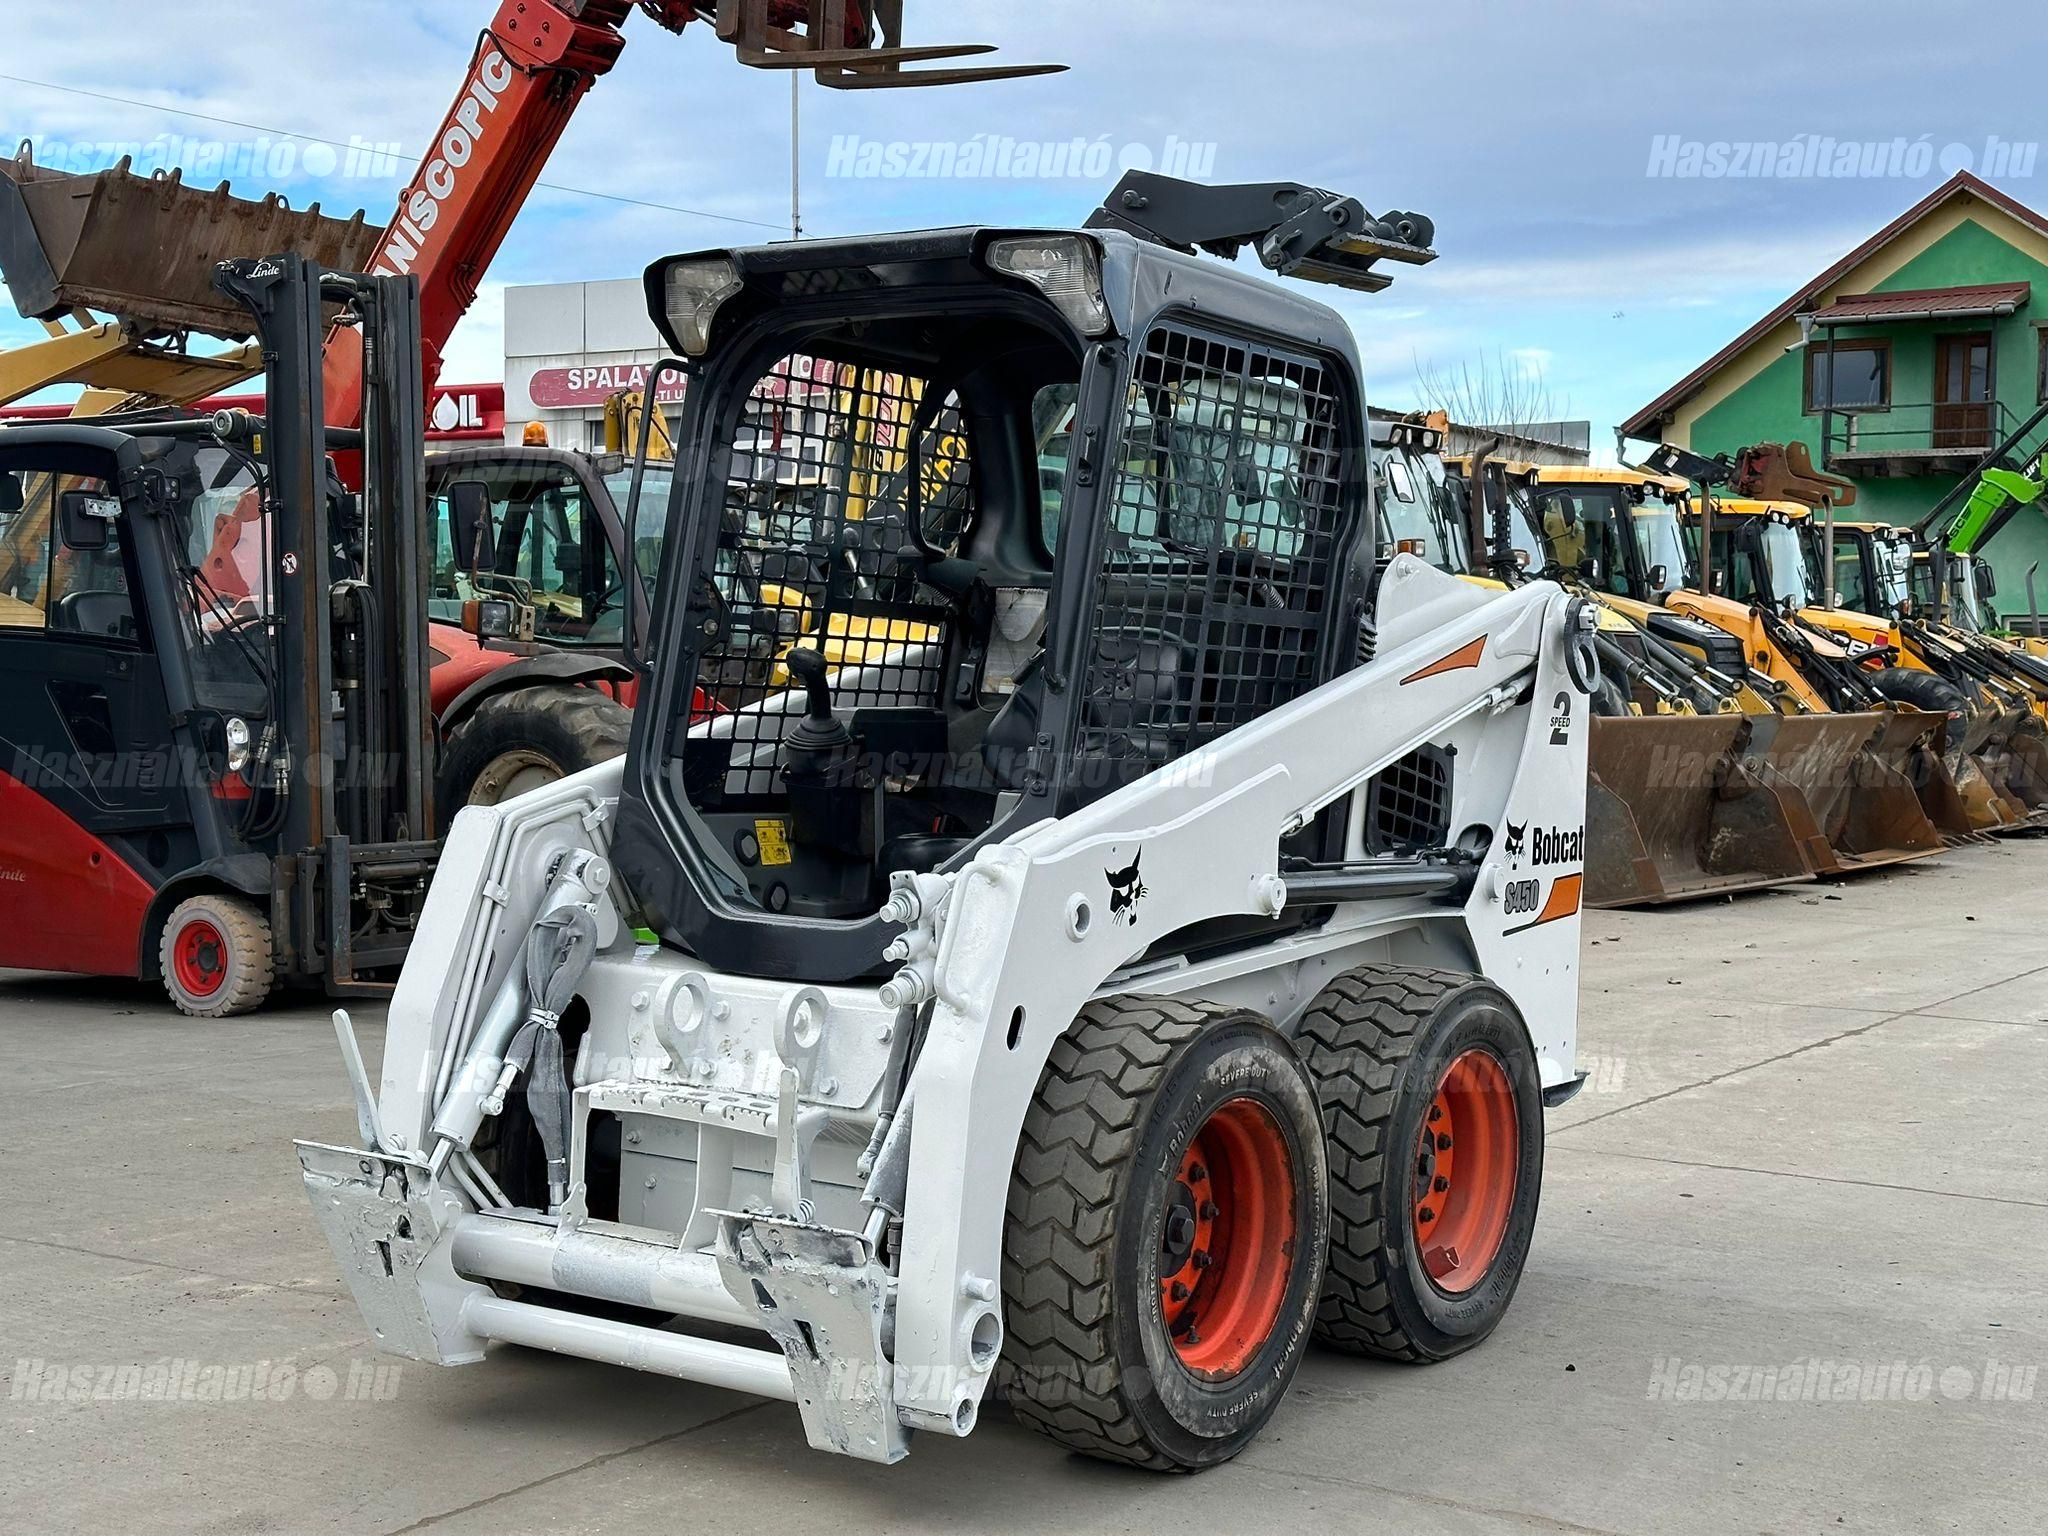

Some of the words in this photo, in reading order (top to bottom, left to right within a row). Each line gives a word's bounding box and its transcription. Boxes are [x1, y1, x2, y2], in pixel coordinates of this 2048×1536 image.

[245, 262, 280, 279] Linde
[1549, 691, 1571, 746] 2
[1550, 715, 1571, 728] SPEED
[1531, 825, 1583, 866] Bobcat
[1504, 878, 1540, 915] S450
